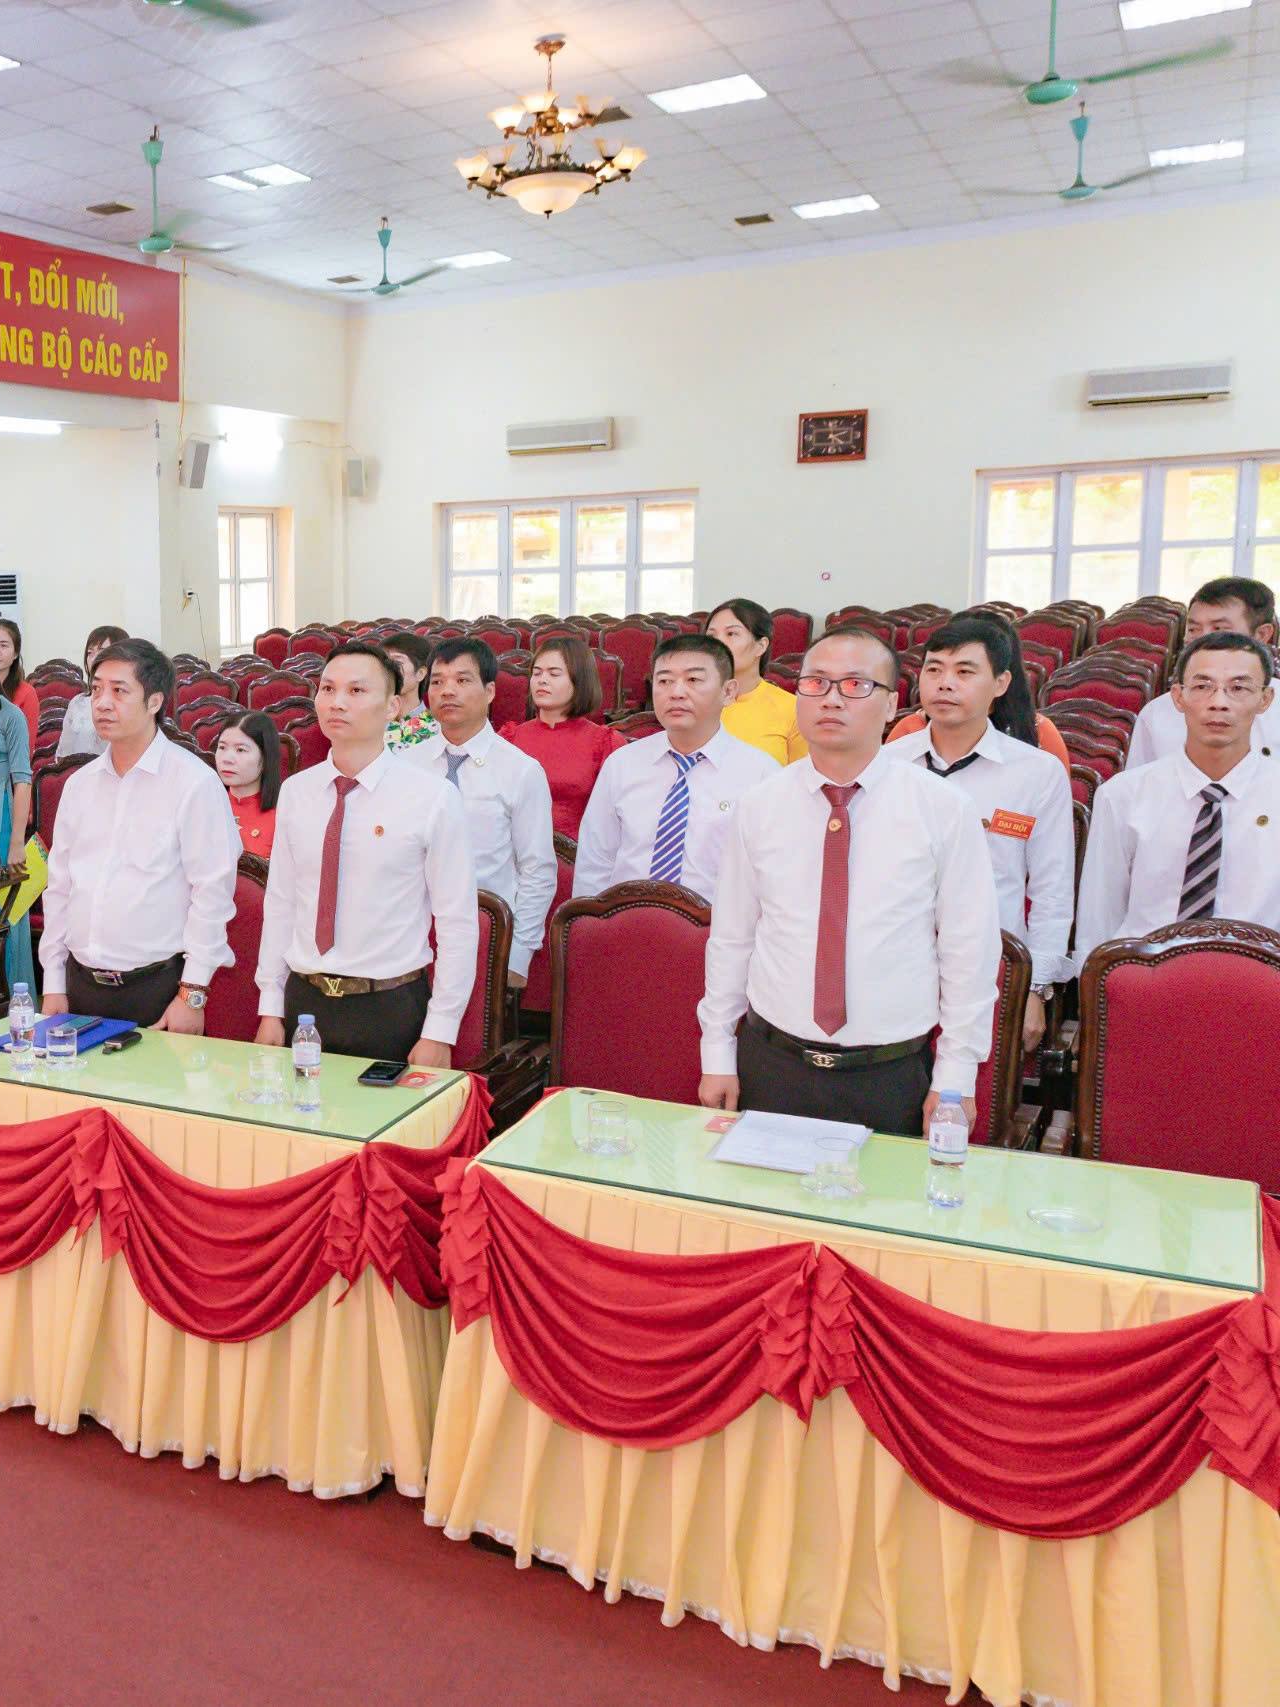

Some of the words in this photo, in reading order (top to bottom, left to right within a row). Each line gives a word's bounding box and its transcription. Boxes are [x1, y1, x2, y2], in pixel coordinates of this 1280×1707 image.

[28, 258, 70, 311] ĐỔI
[76, 272, 125, 325] MỚI,
[41, 326, 73, 379] BỘ
[79, 336, 124, 379] CÁC
[128, 336, 169, 384] CẤP
